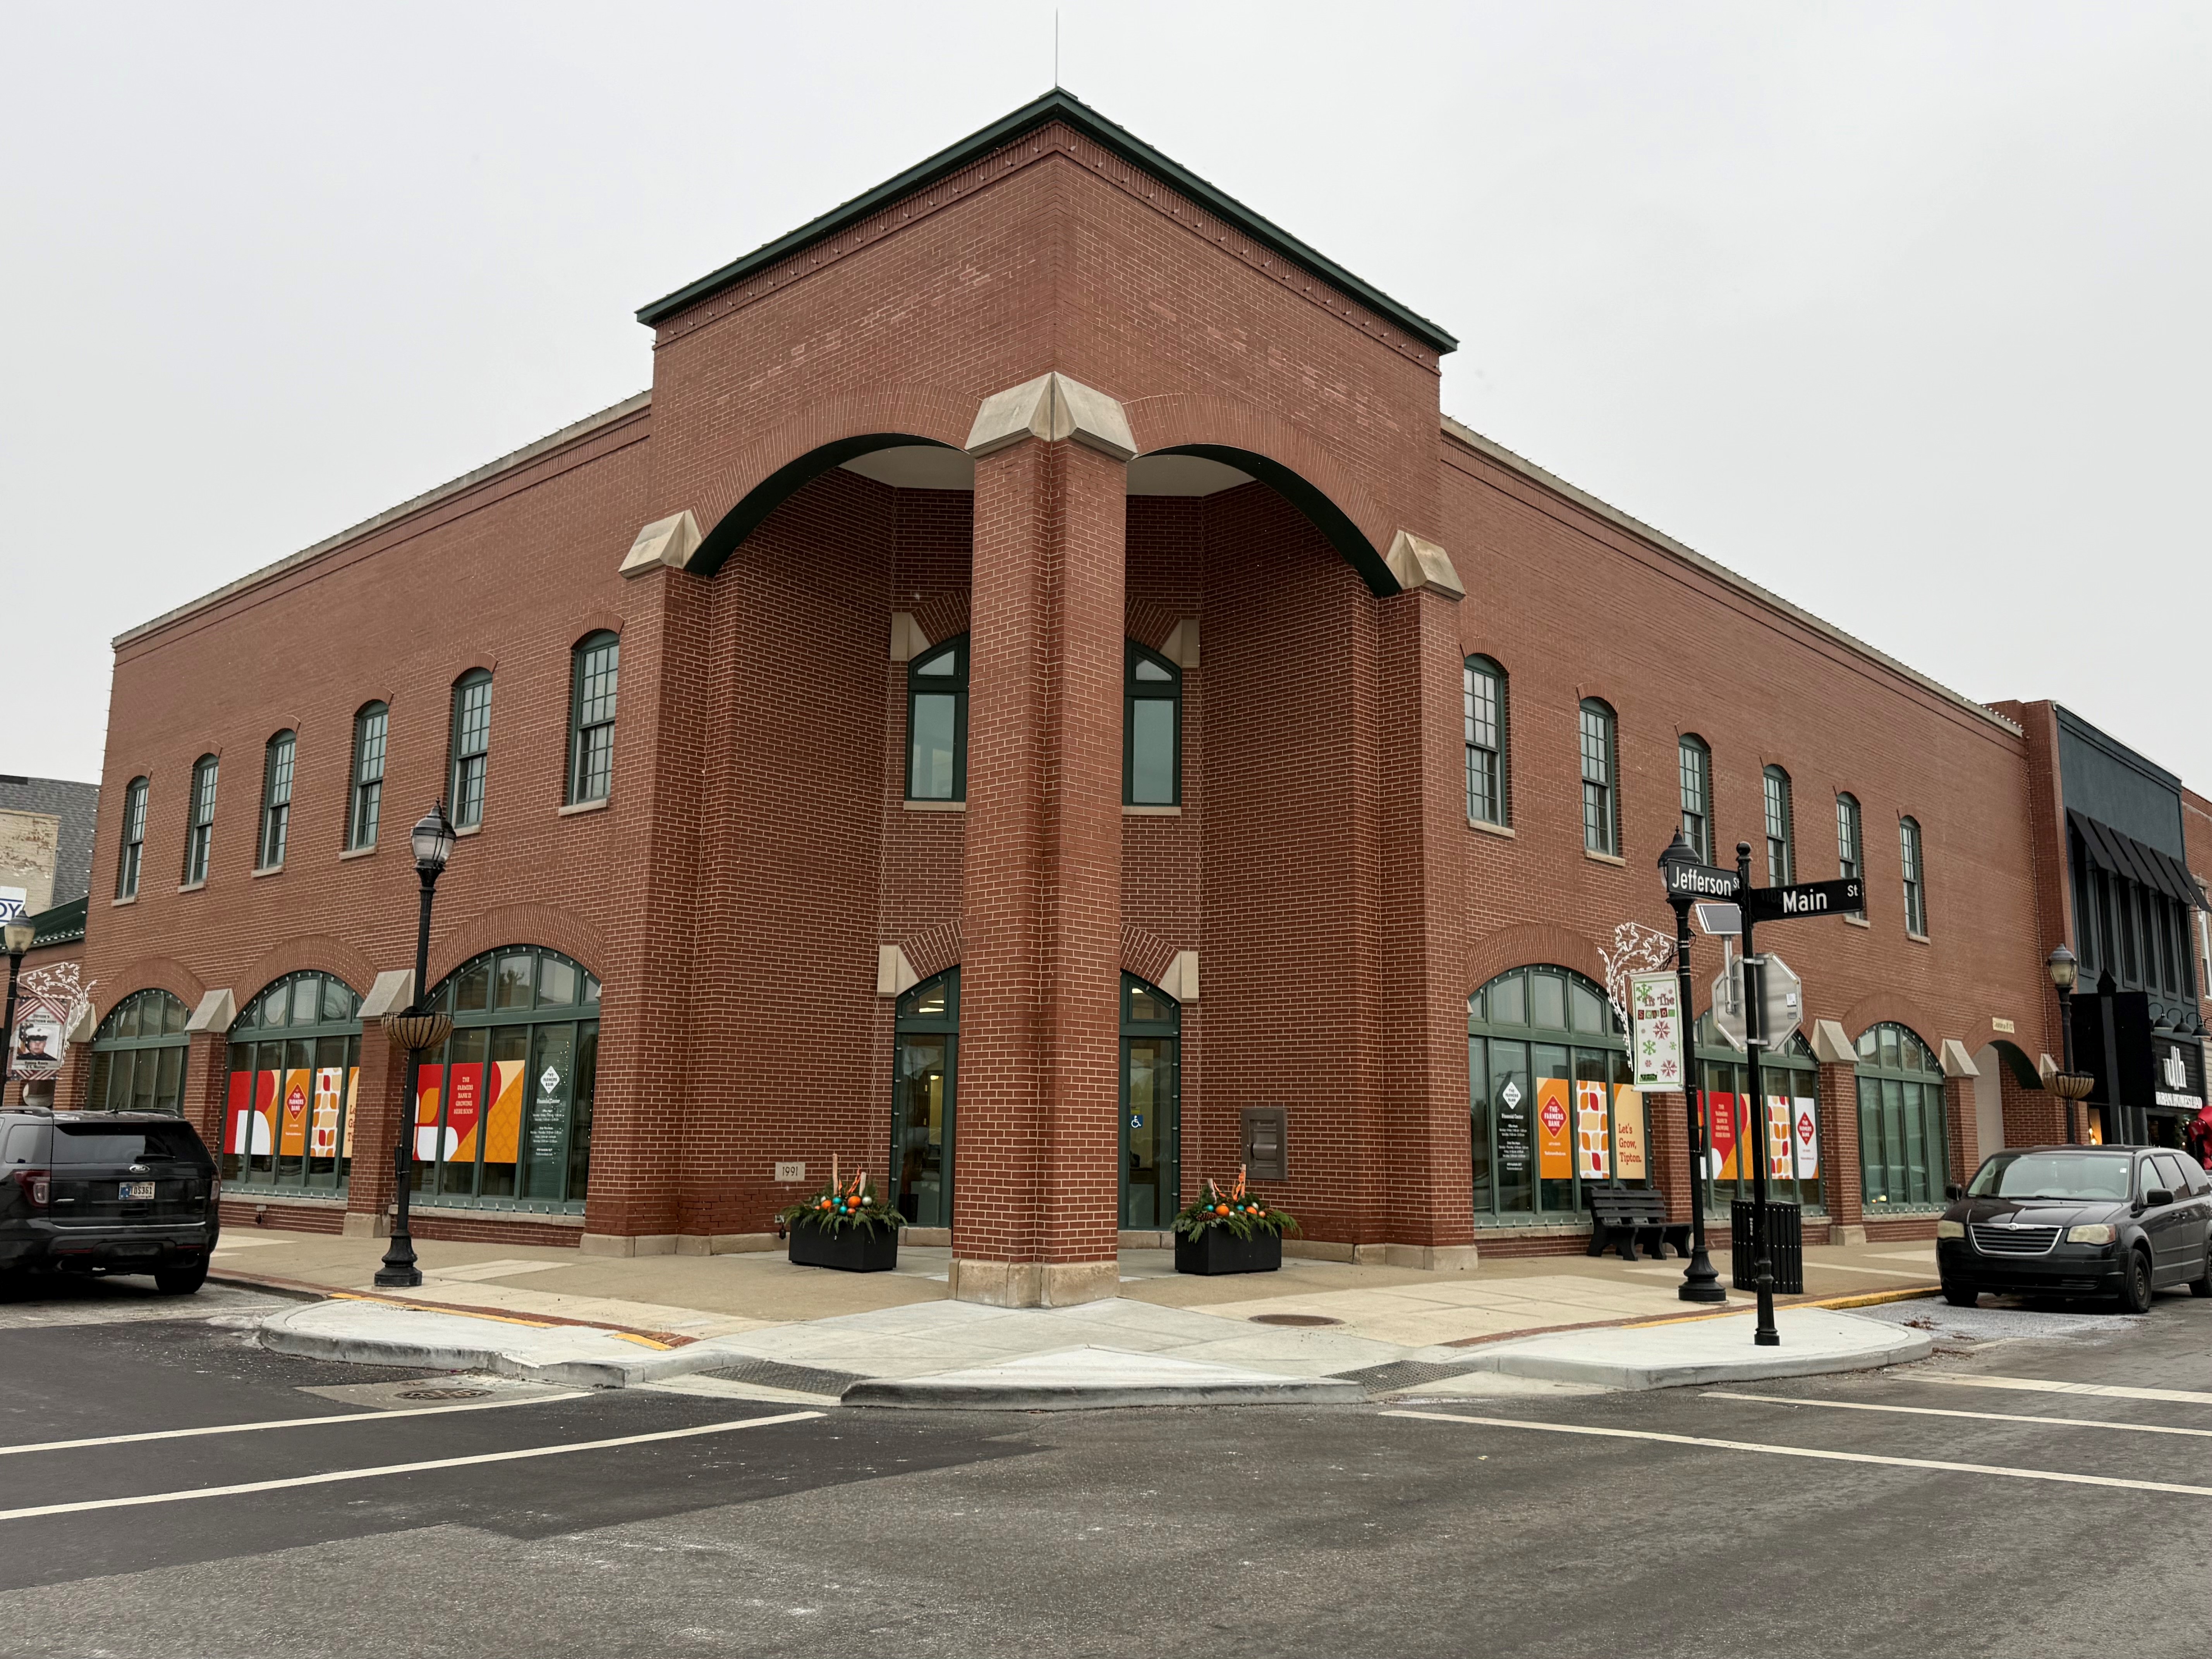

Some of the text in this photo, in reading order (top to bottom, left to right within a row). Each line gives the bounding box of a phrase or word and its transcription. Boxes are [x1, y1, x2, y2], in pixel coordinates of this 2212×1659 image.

[1672, 866, 1740, 896] Jefferson St
[1783, 888, 1827, 913] Main
[1847, 884, 1858, 897] St
[1657, 993, 1675, 1006] The
[1618, 1123, 1633, 1134] Let's
[1619, 1137, 1636, 1149] Grow,
[1620, 1152, 1642, 1165] Tipton.
[782, 1166, 798, 1176] 1991
